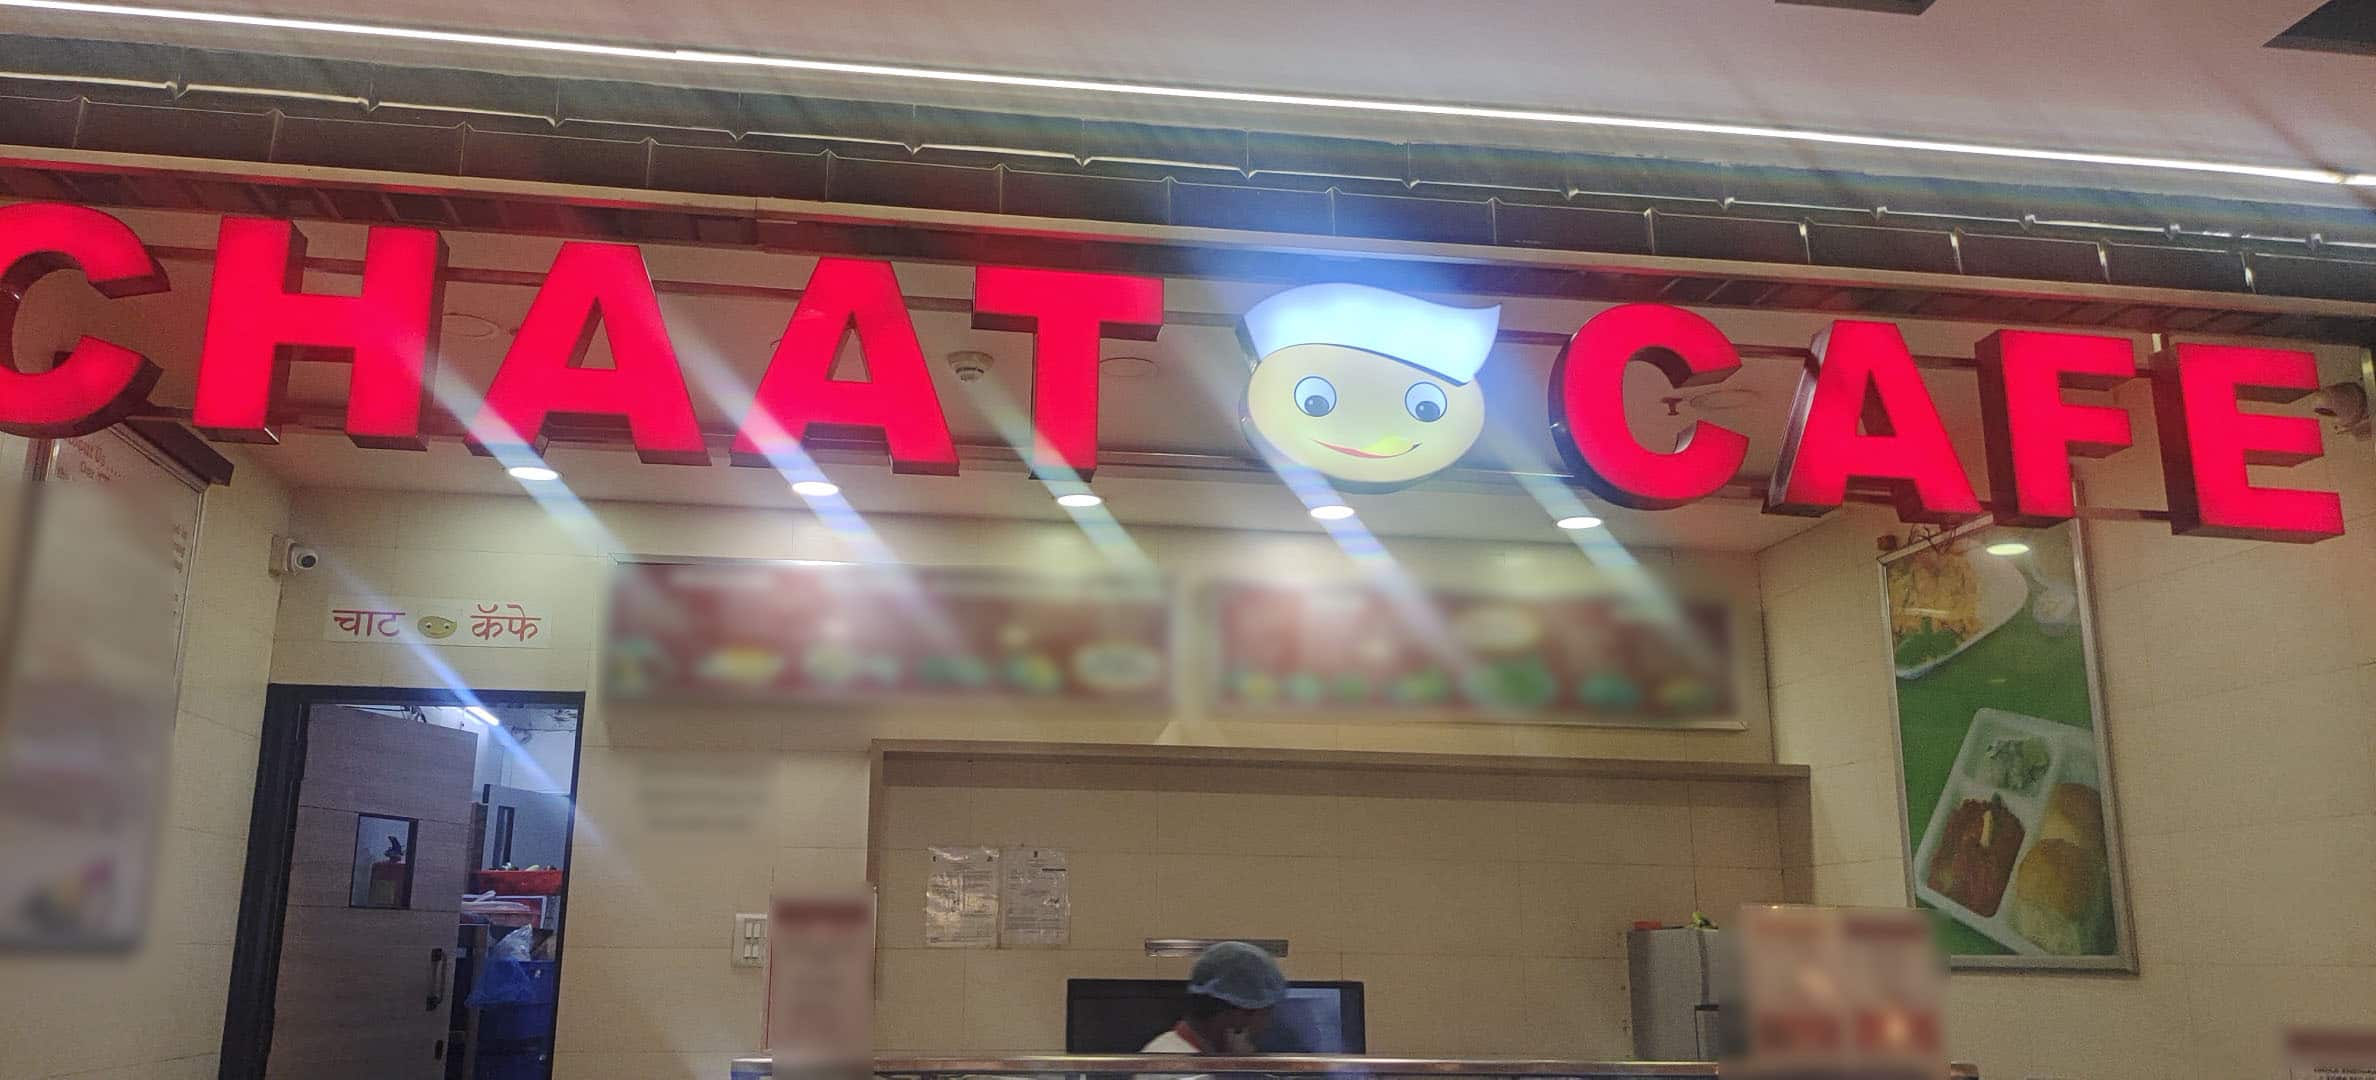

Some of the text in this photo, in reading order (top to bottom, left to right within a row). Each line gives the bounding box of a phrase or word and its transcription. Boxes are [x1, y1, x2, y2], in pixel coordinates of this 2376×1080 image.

[0, 202, 2346, 540] CHAAT CAFE
[332, 609, 406, 637] चाट
